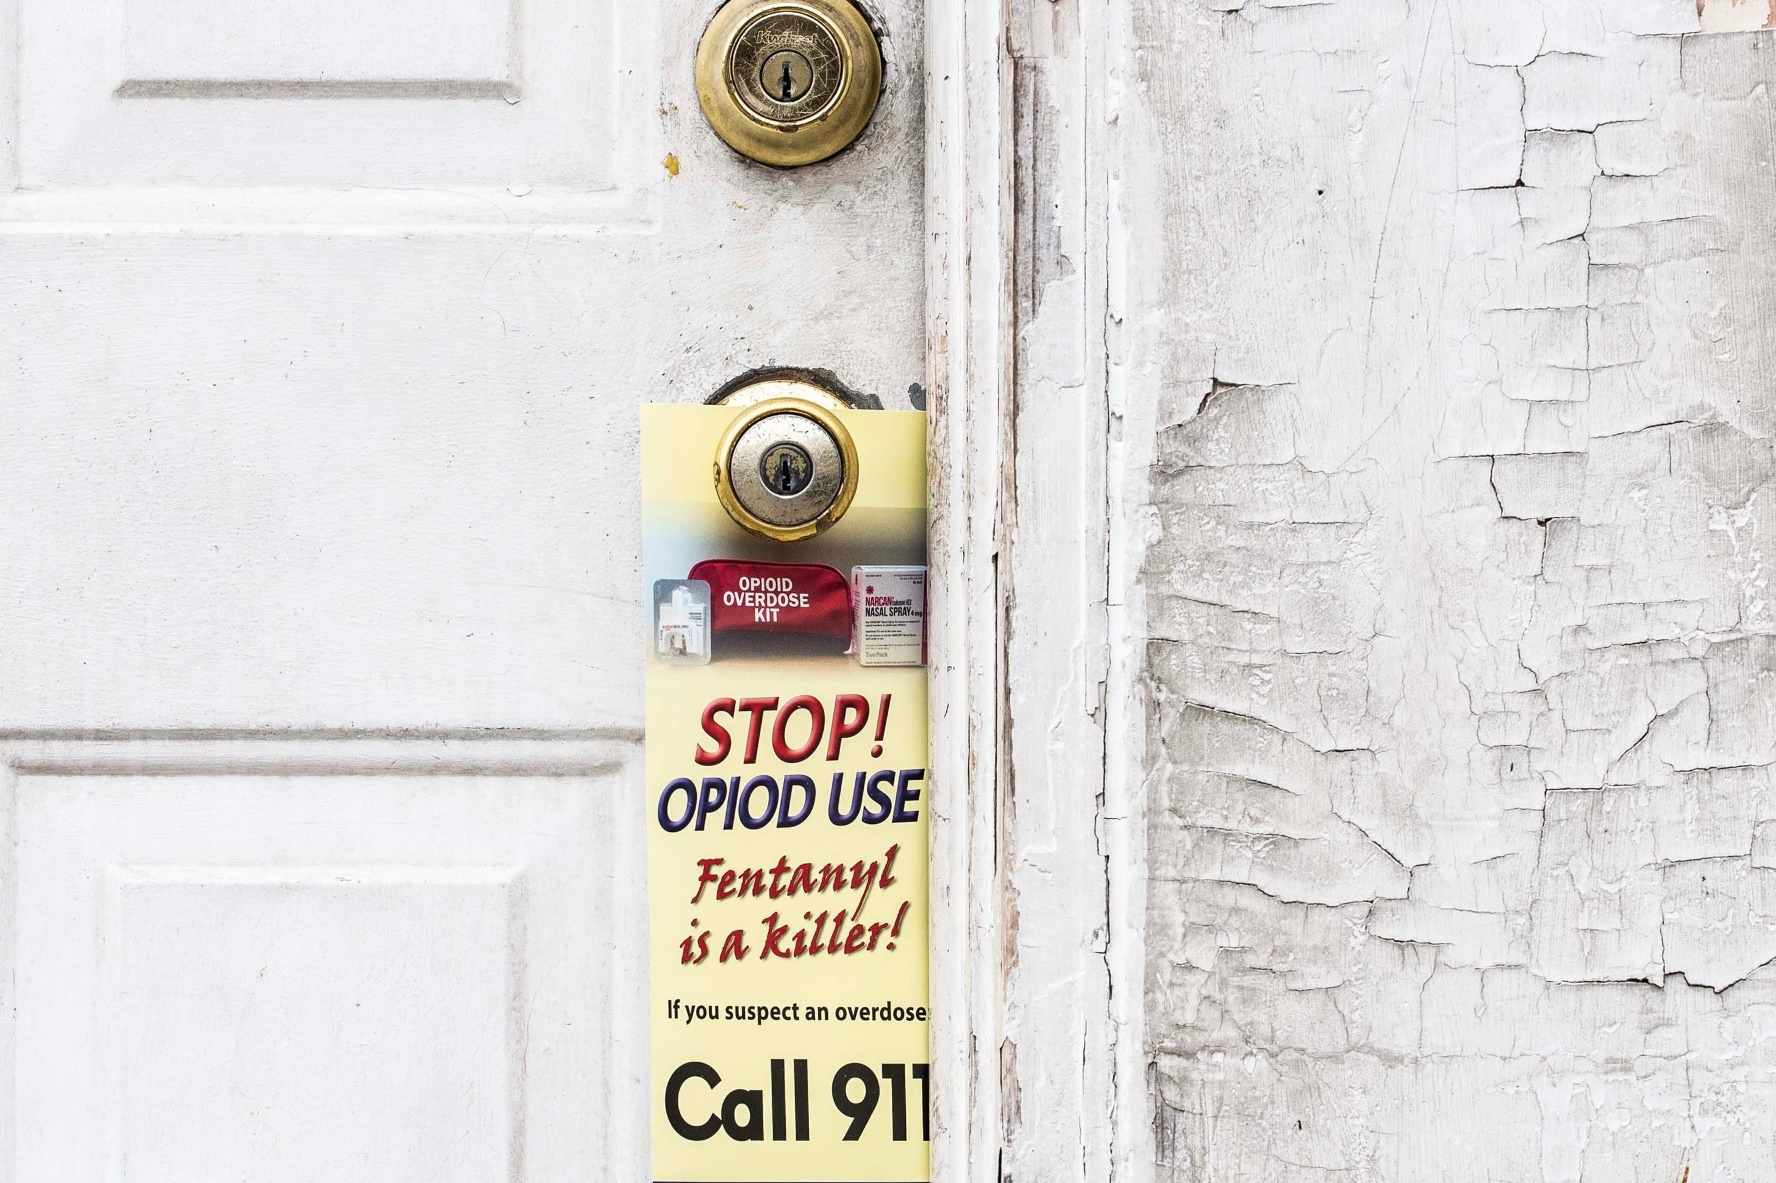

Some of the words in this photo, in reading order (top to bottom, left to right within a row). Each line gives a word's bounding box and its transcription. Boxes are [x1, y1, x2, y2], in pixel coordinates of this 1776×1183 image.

[723, 590, 810, 608] OVERDOSE
[738, 576, 793, 592] OPIOID
[754, 607, 780, 623] KIT
[865, 607, 888, 617] NASAL
[889, 606, 911, 616] SPRAY
[695, 694, 891, 766] STOP!
[657, 774, 816, 833] OPIOD
[826, 769, 925, 826] USE
[691, 844, 900, 921] Fentanyl
[679, 919, 710, 965] is
[719, 930, 749, 963] a
[760, 901, 909, 961] killer!
[667, 999, 681, 1019] If
[684, 1005, 720, 1025] you
[725, 1003, 800, 1025] suspect
[805, 1006, 829, 1021] an
[664, 1058, 810, 1142] Call
[831, 1062, 931, 1142] 911
